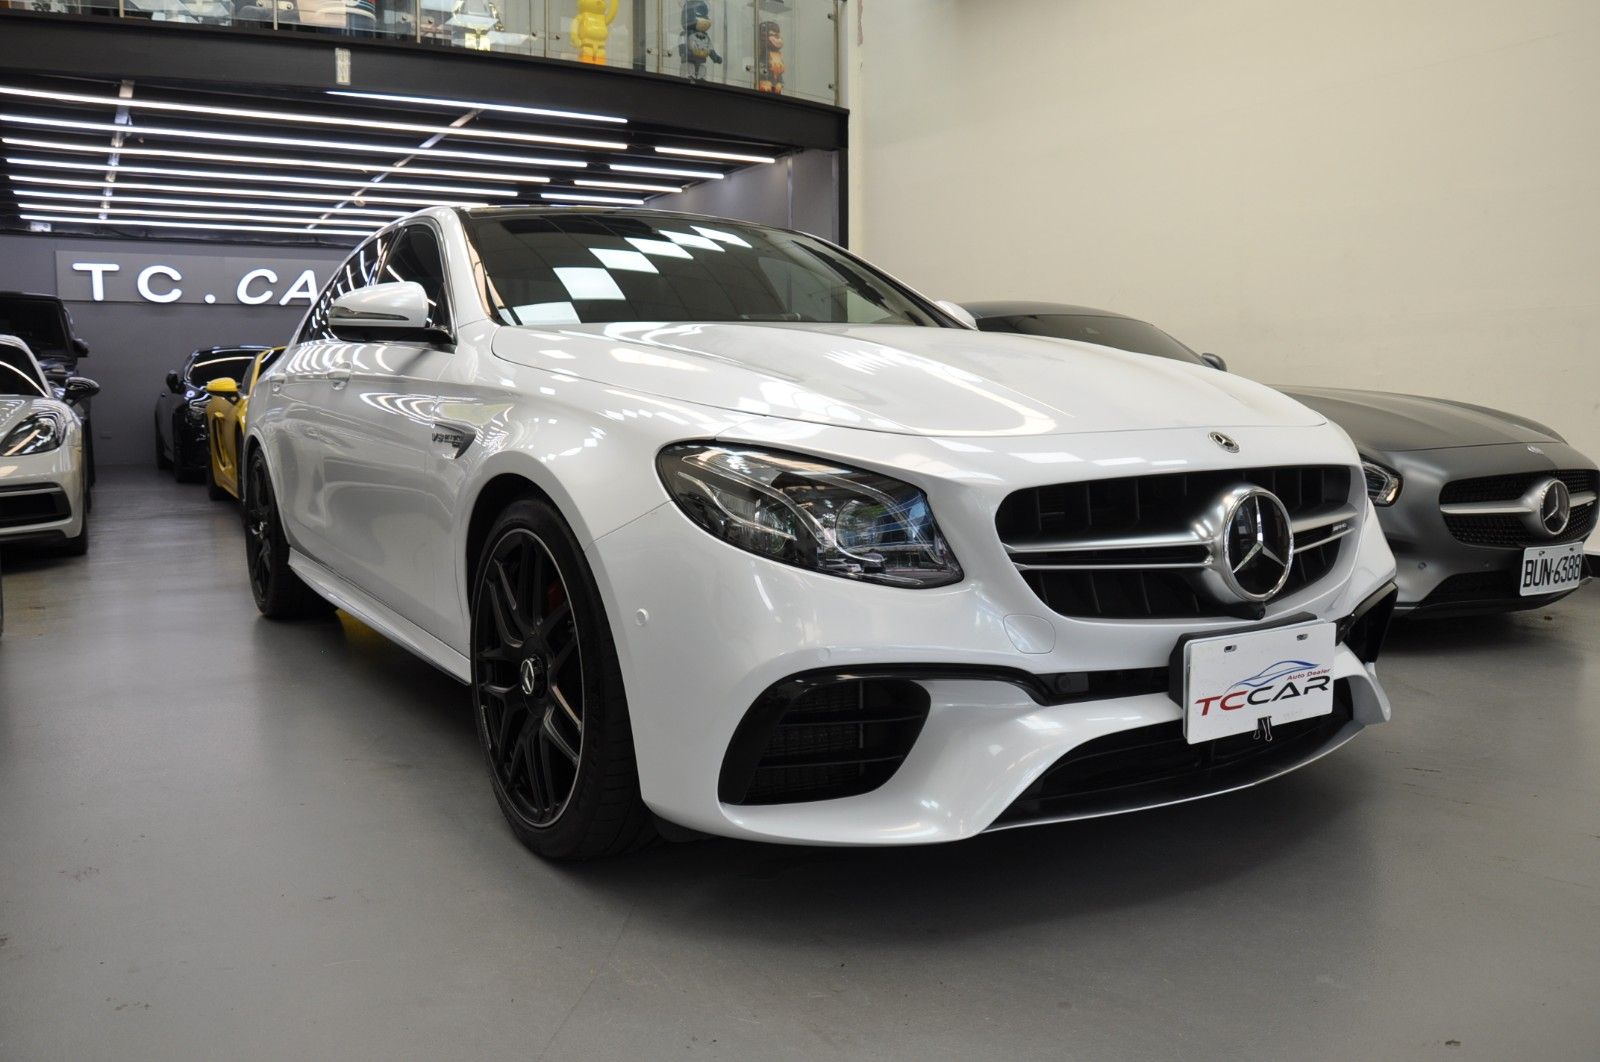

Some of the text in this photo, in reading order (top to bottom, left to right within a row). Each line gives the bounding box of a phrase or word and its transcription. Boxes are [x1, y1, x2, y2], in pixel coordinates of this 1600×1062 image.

[1286, 668, 1332, 681] Auto Dealer
[1194, 675, 1331, 717] TCCAR
